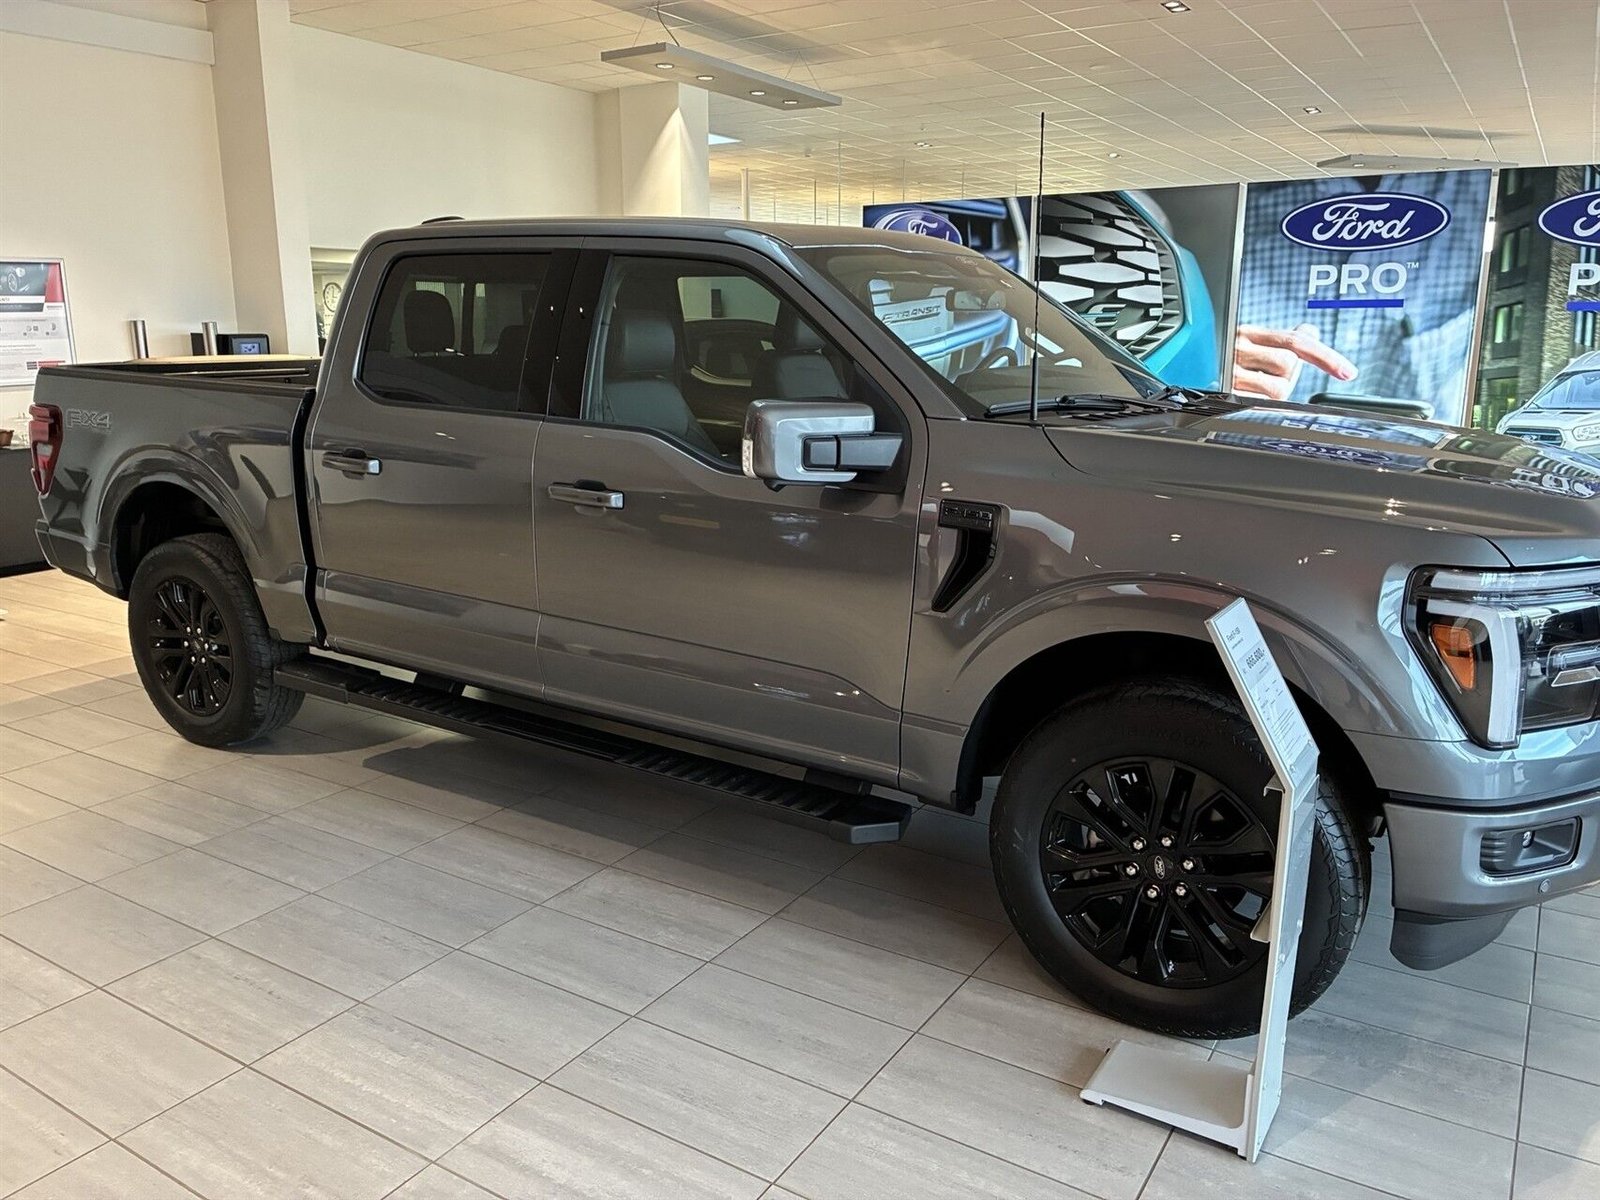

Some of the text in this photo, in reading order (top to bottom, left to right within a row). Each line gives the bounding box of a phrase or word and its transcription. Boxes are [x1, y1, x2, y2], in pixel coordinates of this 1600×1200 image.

[1312, 203, 1415, 240] Ford
[1308, 262, 1407, 294] PRO
[66, 408, 109, 428] FX4
